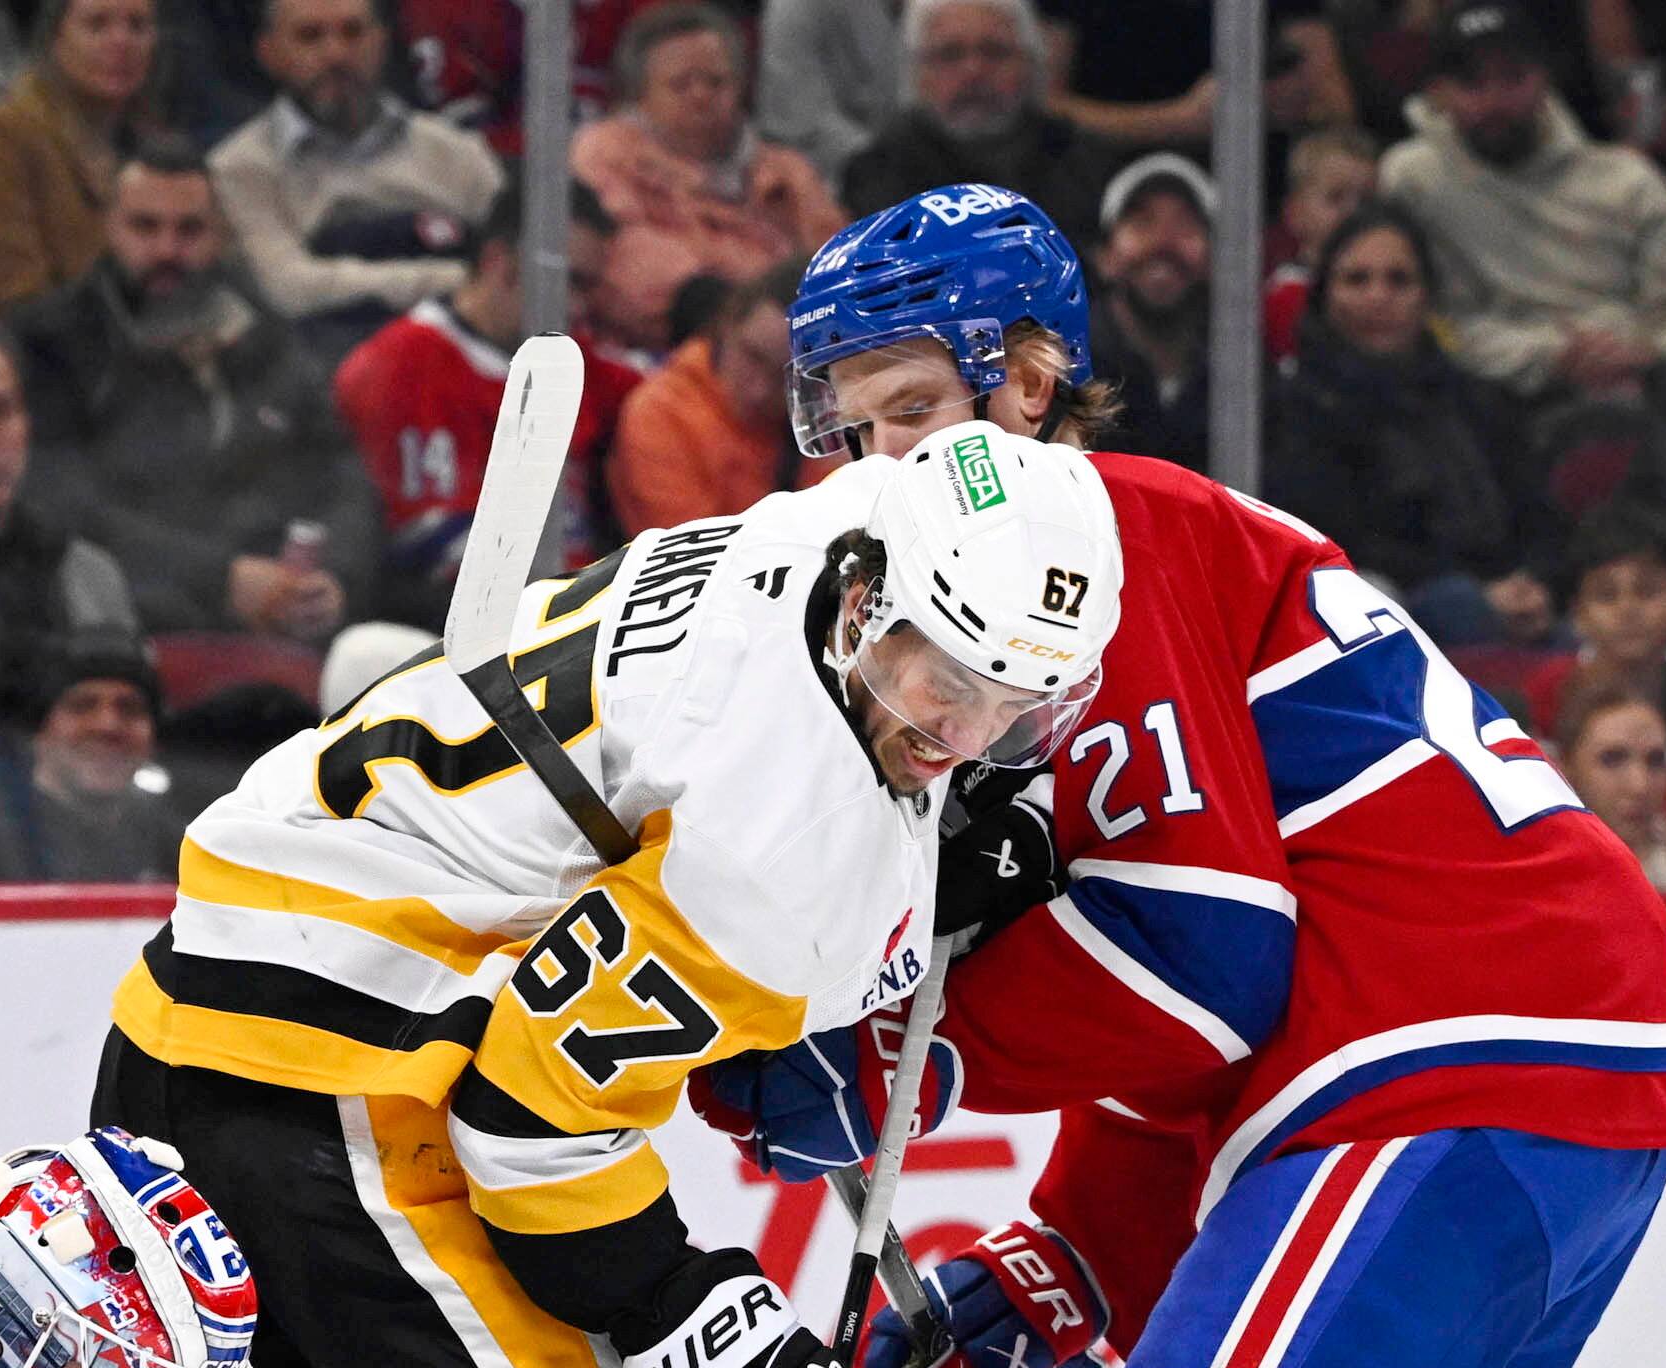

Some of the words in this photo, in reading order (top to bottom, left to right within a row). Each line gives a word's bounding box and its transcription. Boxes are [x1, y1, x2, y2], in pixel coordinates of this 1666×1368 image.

[919, 183, 1011, 226] Bell
[792, 302, 836, 330] BAUER
[399, 430, 459, 498] 14
[942, 446, 951, 459] The
[944, 458, 958, 481] Safety
[955, 436, 1001, 508] MSA
[952, 480, 970, 516] Company
[605, 523, 744, 678] RAKELL
[1042, 566, 1090, 619] 67
[1006, 637, 1077, 664] CCM
[1069, 701, 1206, 841] 21
[509, 887, 725, 1091] 67
[841, 1310, 859, 1344] RAKELL
